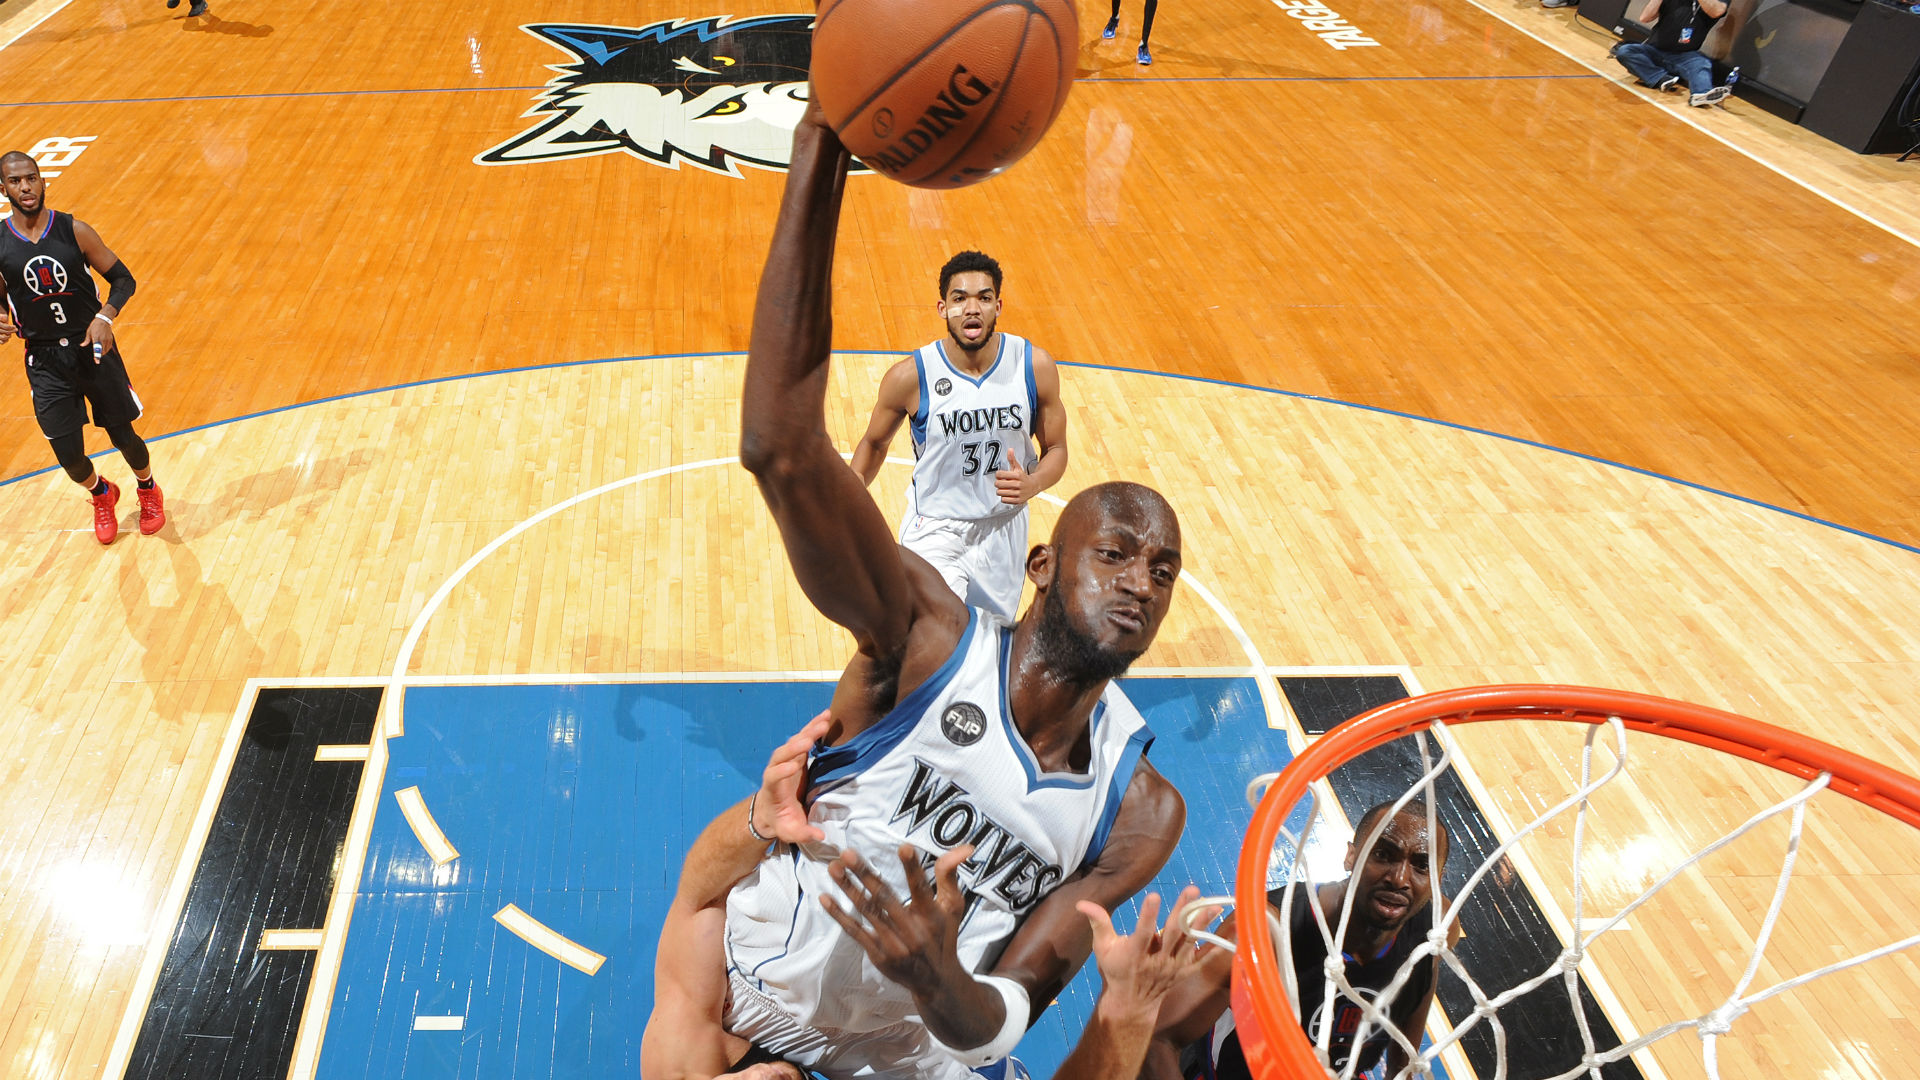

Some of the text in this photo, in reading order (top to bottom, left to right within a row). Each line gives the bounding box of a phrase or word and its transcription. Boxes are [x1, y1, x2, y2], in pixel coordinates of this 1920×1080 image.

[50, 302, 67, 324] 3
[936, 403, 1023, 444] WOLVES
[961, 439, 1002, 477] 32
[945, 710, 981, 736] FLIP
[888, 756, 1063, 912] WOLVES
